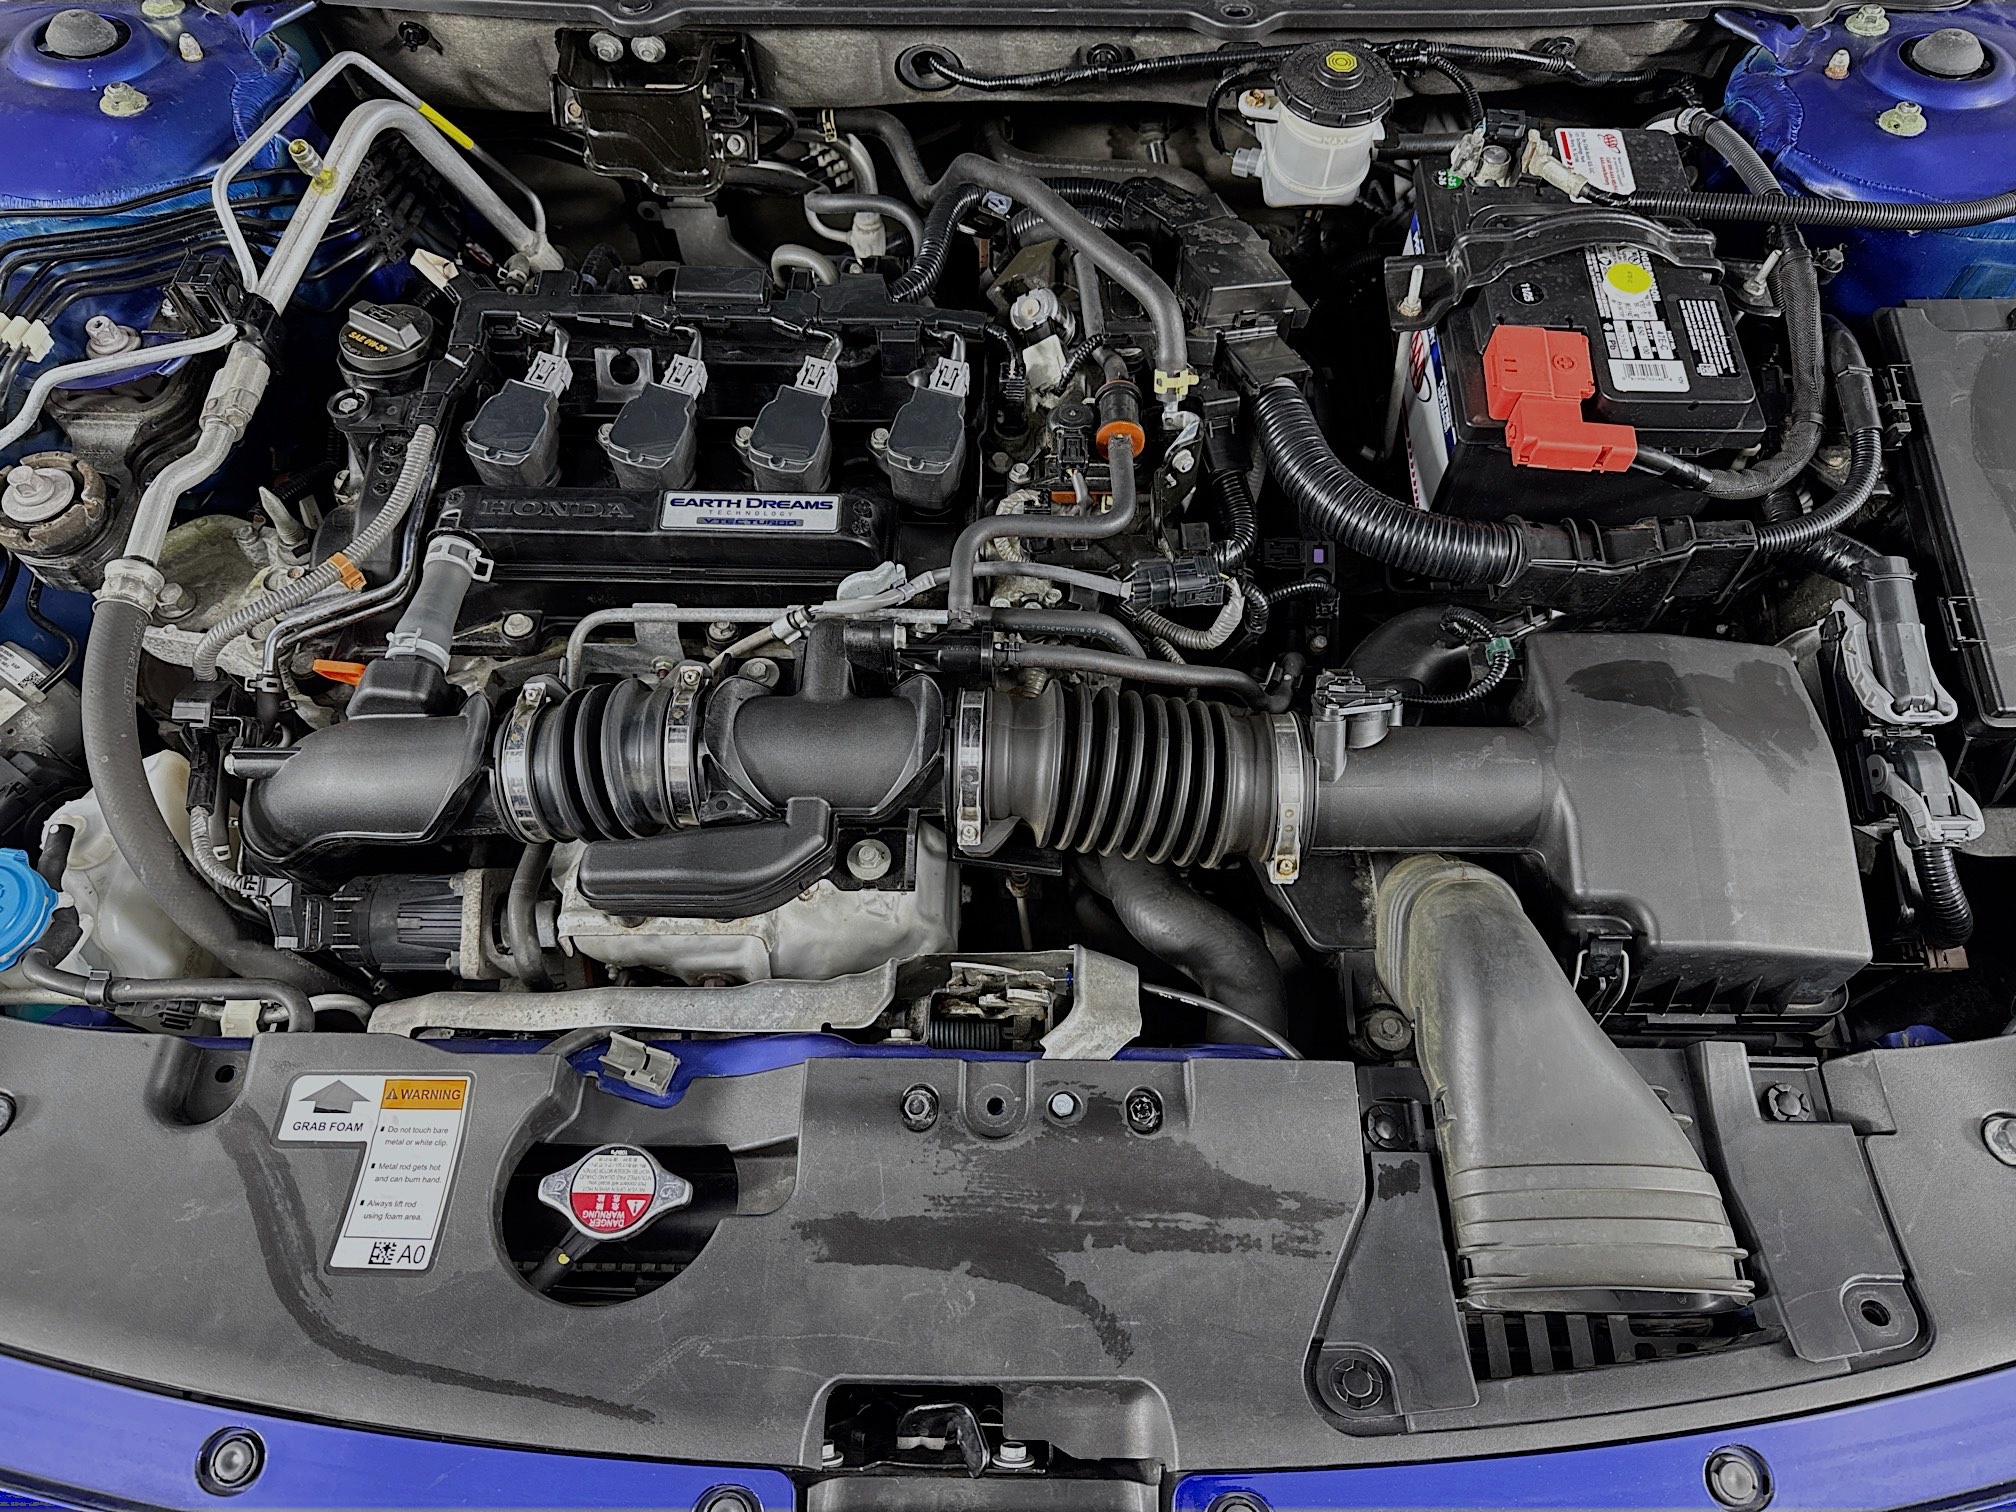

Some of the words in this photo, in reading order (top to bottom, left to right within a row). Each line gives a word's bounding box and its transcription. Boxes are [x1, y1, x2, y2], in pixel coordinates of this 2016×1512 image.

[348, 331, 367, 343] SAE
[363, 338, 388, 352] 0W-20
[1609, 340, 1617, 350] Pb
[1657, 331, 1669, 350] 47E-C
[670, 498, 743, 509] EARTH
[745, 498, 834, 510] DREAMS
[479, 501, 634, 518] HONDA
[400, 1089, 461, 1100] WARNING
[293, 1122, 326, 1131] GRAB
[329, 1122, 364, 1132] FOAM
[400, 1126, 411, 1134] not
[412, 1126, 432, 1134] touch
[433, 1126, 449, 1134] bare
[434, 1139, 448, 1147] clip.
[399, 1163, 412, 1171] rod
[412, 1164, 428, 1172] gets
[367, 1200, 393, 1209] Always
[394, 1200, 403, 1208] lift
[363, 1213, 383, 1221] using
[582, 1210, 625, 1219] WARNUNG
[589, 1219, 625, 1227] DANGER
[397, 1245, 425, 1264] A0
